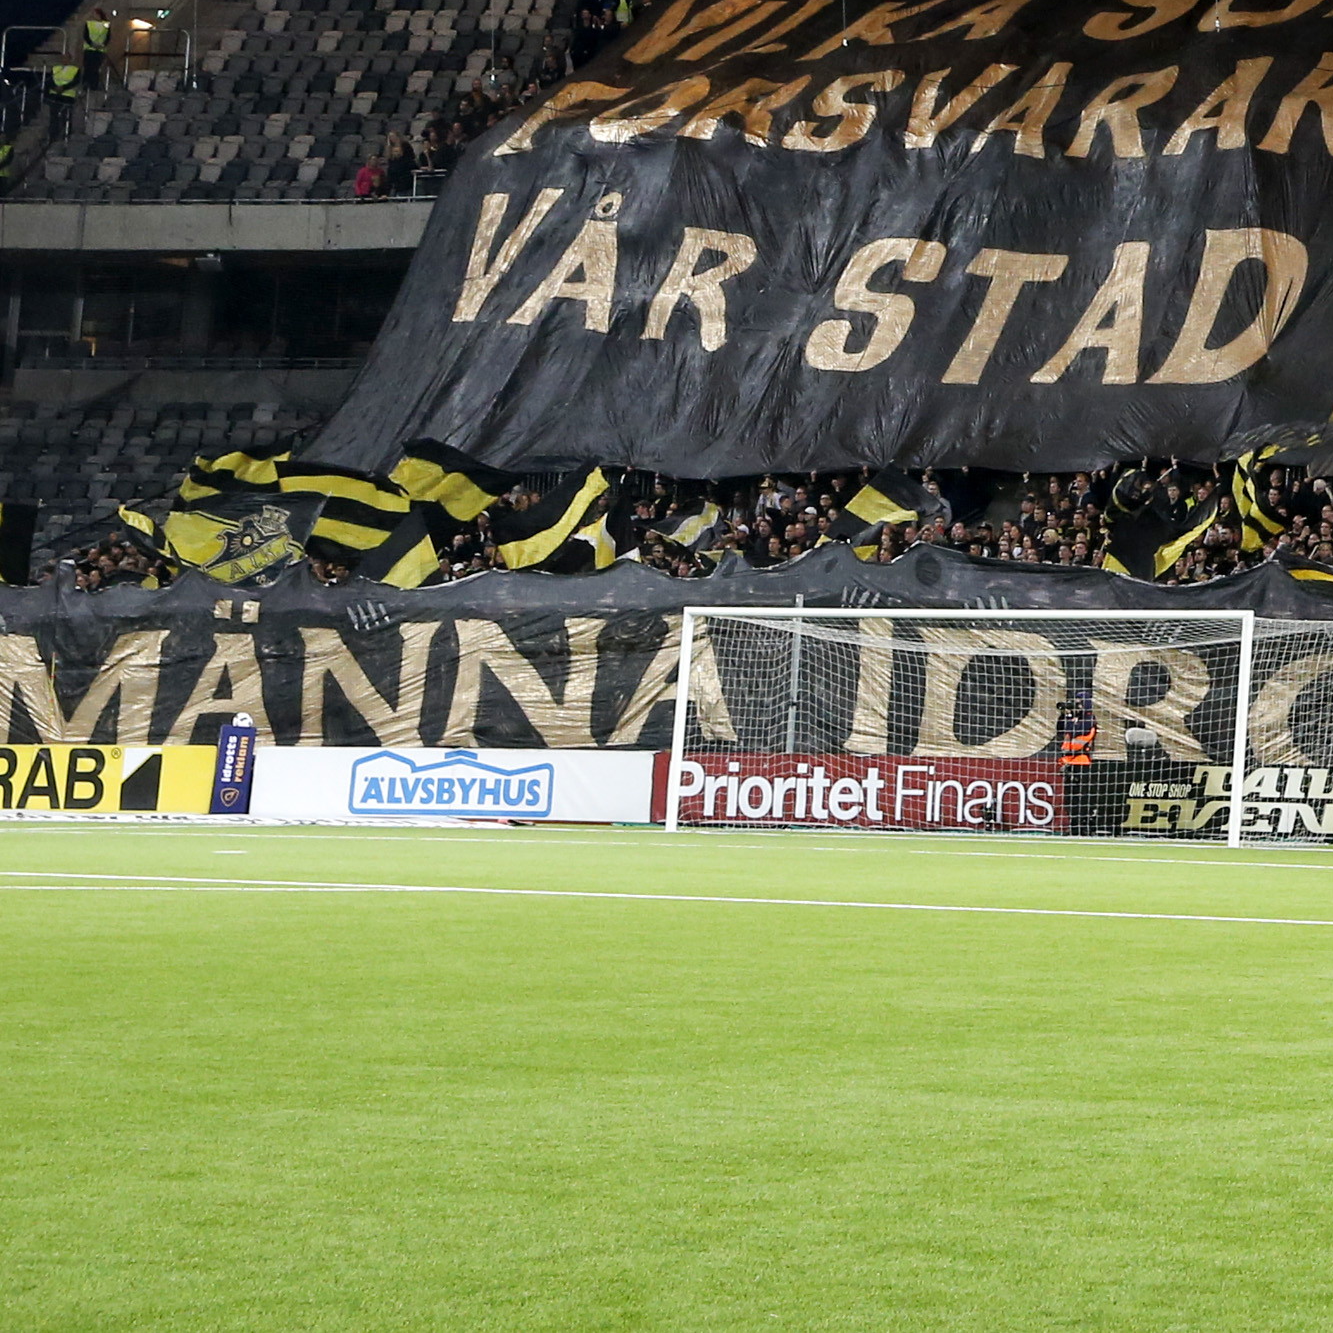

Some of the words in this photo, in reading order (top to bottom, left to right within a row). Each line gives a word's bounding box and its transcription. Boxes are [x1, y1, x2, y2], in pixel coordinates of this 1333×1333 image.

[452, 186, 757, 353] VÅR
[804, 227, 1309, 386] STAD
[221, 735, 238, 783] idrotts
[233, 736, 250, 783] reklam
[360, 776, 541, 807] ÄLVSBYHUS
[677, 760, 886, 822] Prioritet
[894, 764, 1055, 826] Finans
[1129, 782, 1148, 797] ONE
[1148, 783, 1169, 798] STOP
[1169, 783, 1192, 799] SHOP
